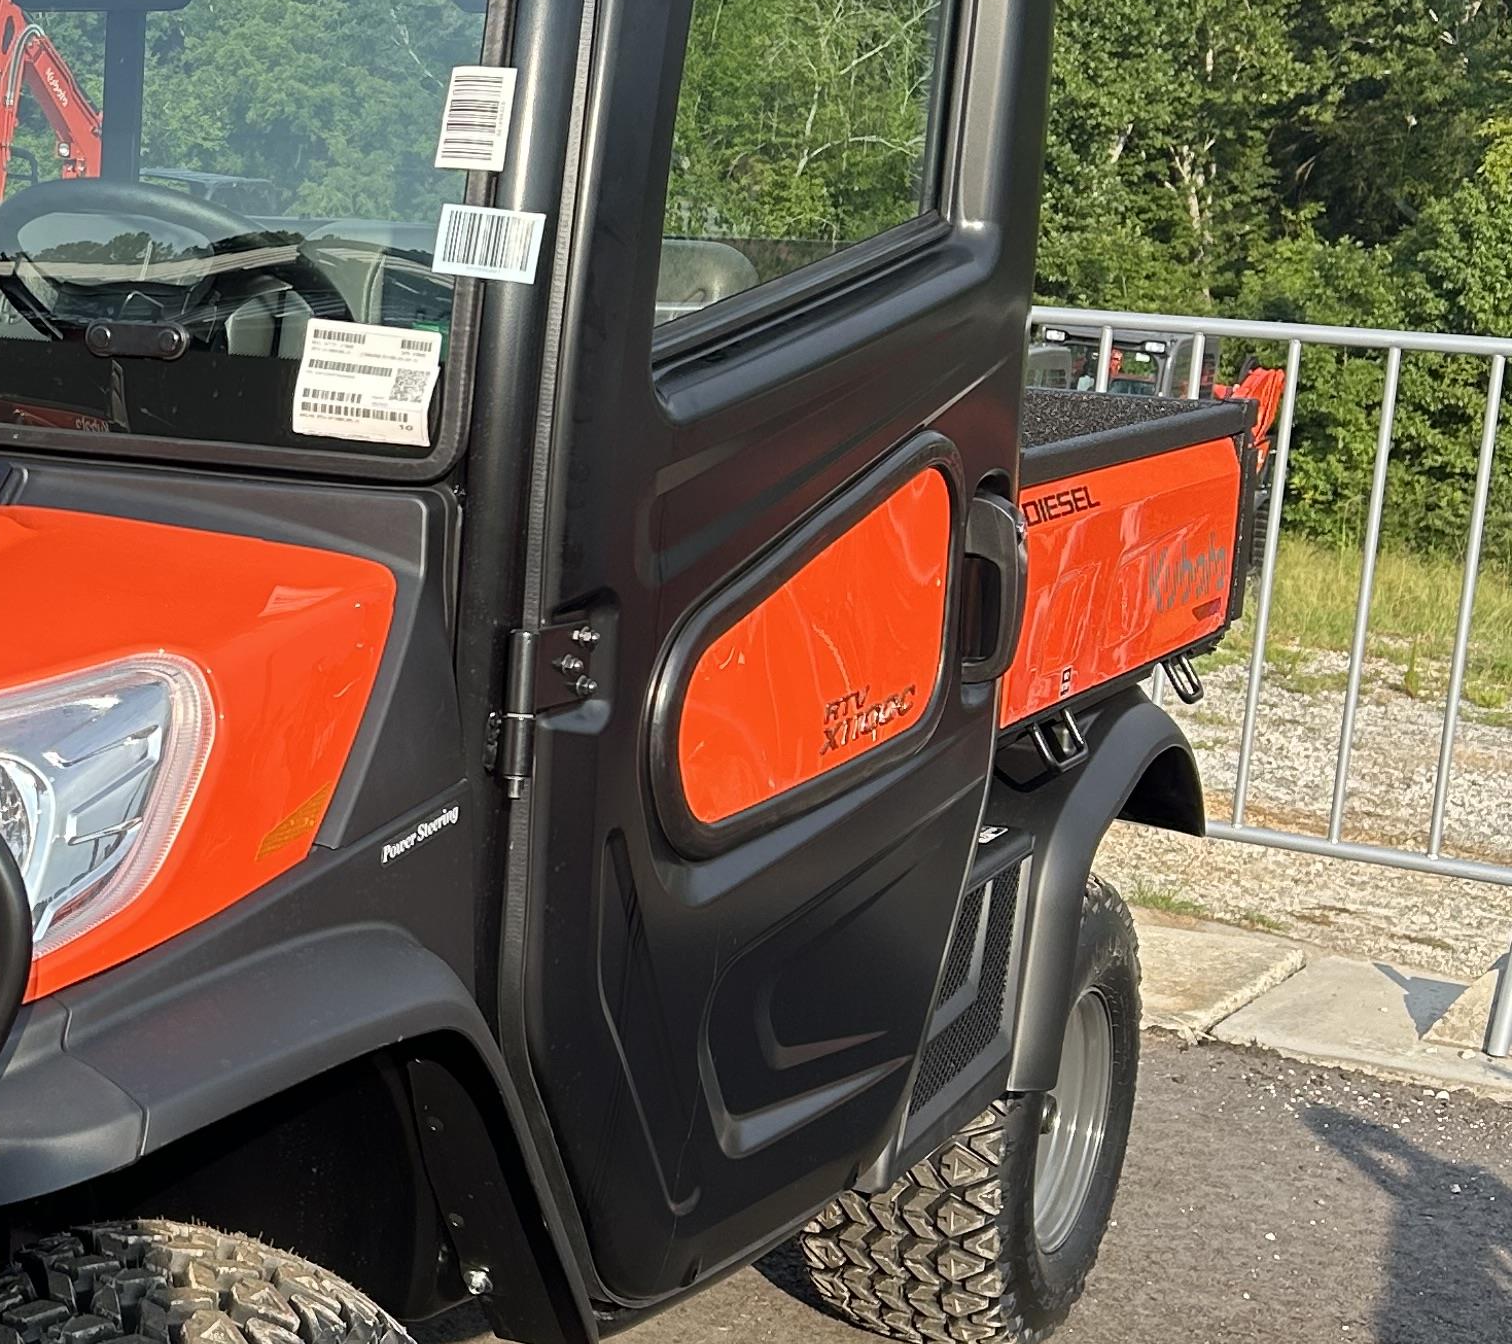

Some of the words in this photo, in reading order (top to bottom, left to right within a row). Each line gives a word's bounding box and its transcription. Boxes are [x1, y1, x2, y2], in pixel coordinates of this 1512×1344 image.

[45, 67, 68, 107] Kubota
[1021, 486, 1101, 527] DIESEL
[1148, 529, 1226, 614] Kubota
[823, 684, 870, 725] RTV
[381, 832, 417, 864] Power
[416, 806, 460, 842] Steering
